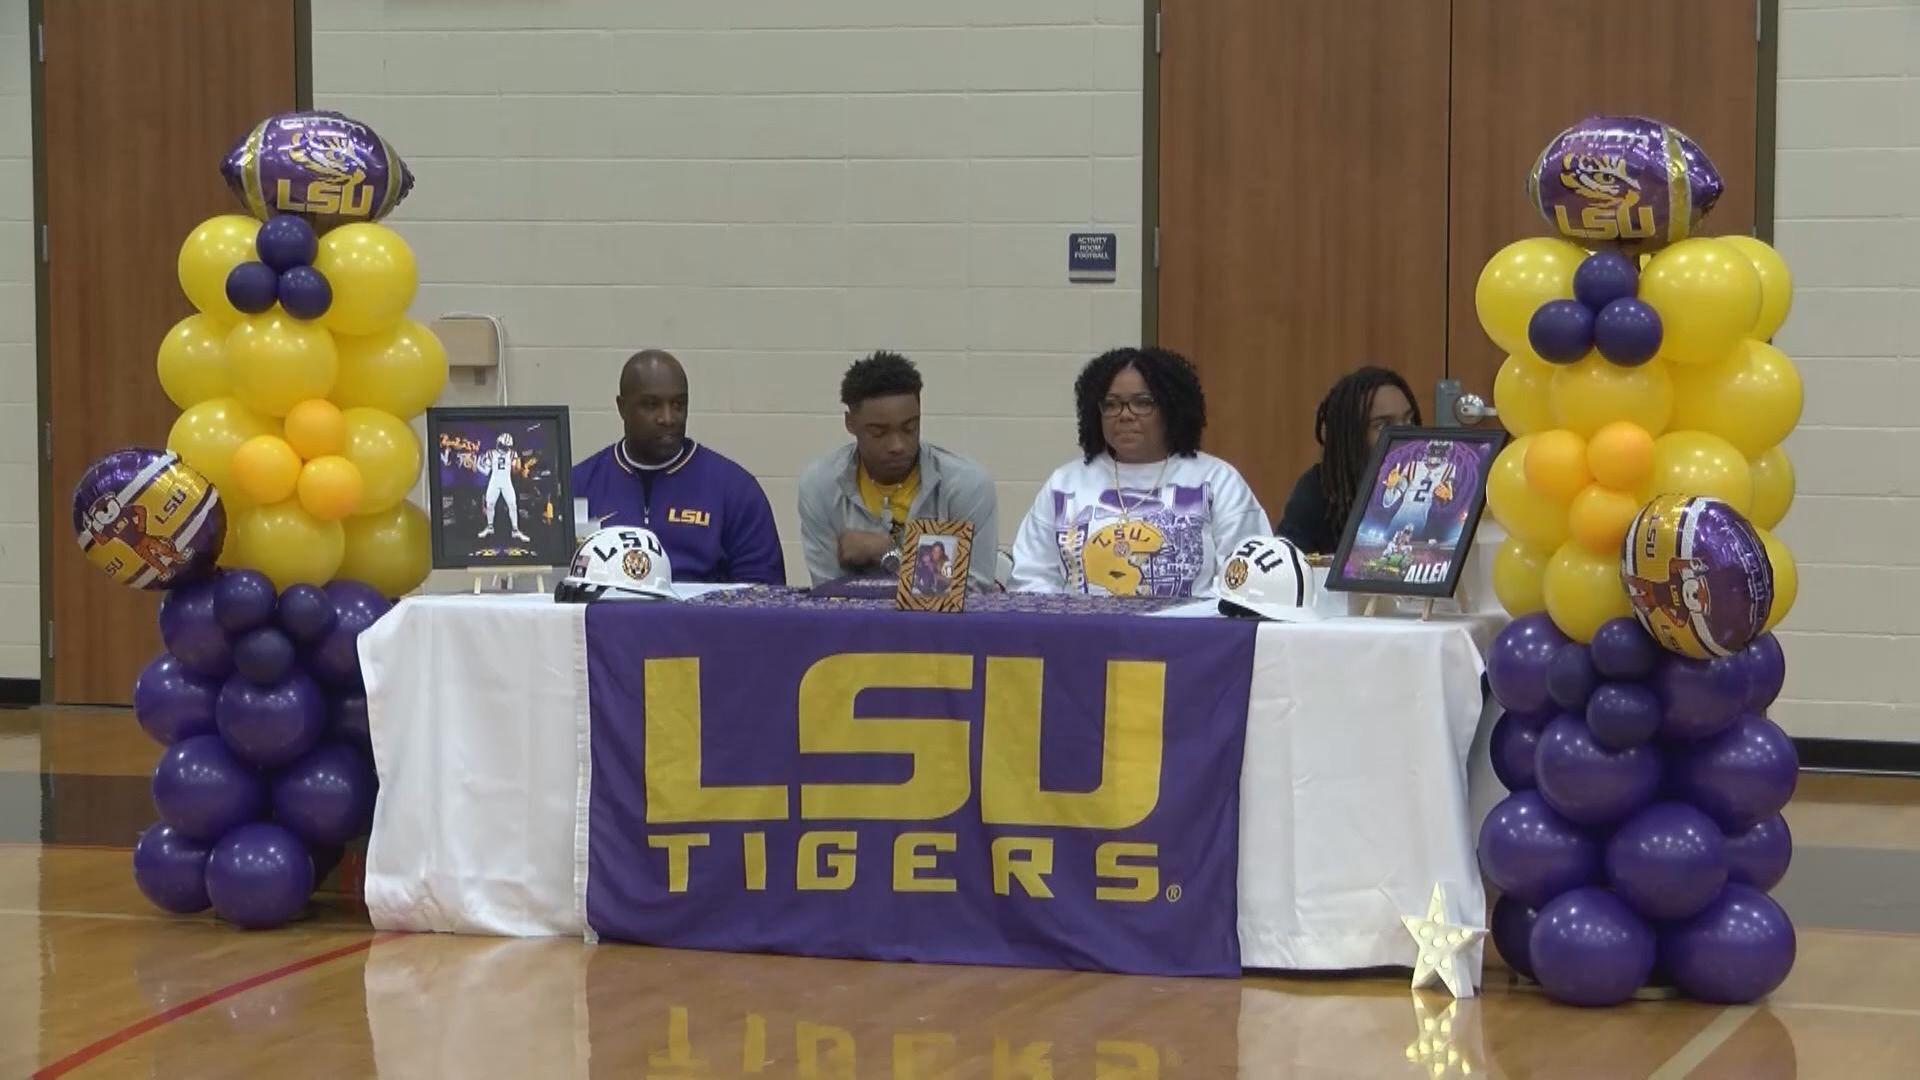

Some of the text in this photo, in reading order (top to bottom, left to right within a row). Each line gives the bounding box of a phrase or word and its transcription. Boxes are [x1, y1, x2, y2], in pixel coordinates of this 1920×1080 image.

[276, 178, 374, 216] LSU
[1554, 204, 1656, 239] LSU
[1077, 236, 1107, 244] ACTIVITY
[1074, 251, 1108, 259] FOOTBALL
[497, 456, 506, 470] 2
[1413, 479, 1433, 503] 2
[154, 488, 187, 525] LSU
[668, 507, 711, 527] LSU
[592, 531, 663, 563] LSU
[1236, 540, 1283, 574] SU
[104, 556, 125, 578] SU
[1403, 560, 1452, 585] ALLEN
[644, 652, 1165, 829] LSU
[647, 831, 1159, 903] TIGERS
